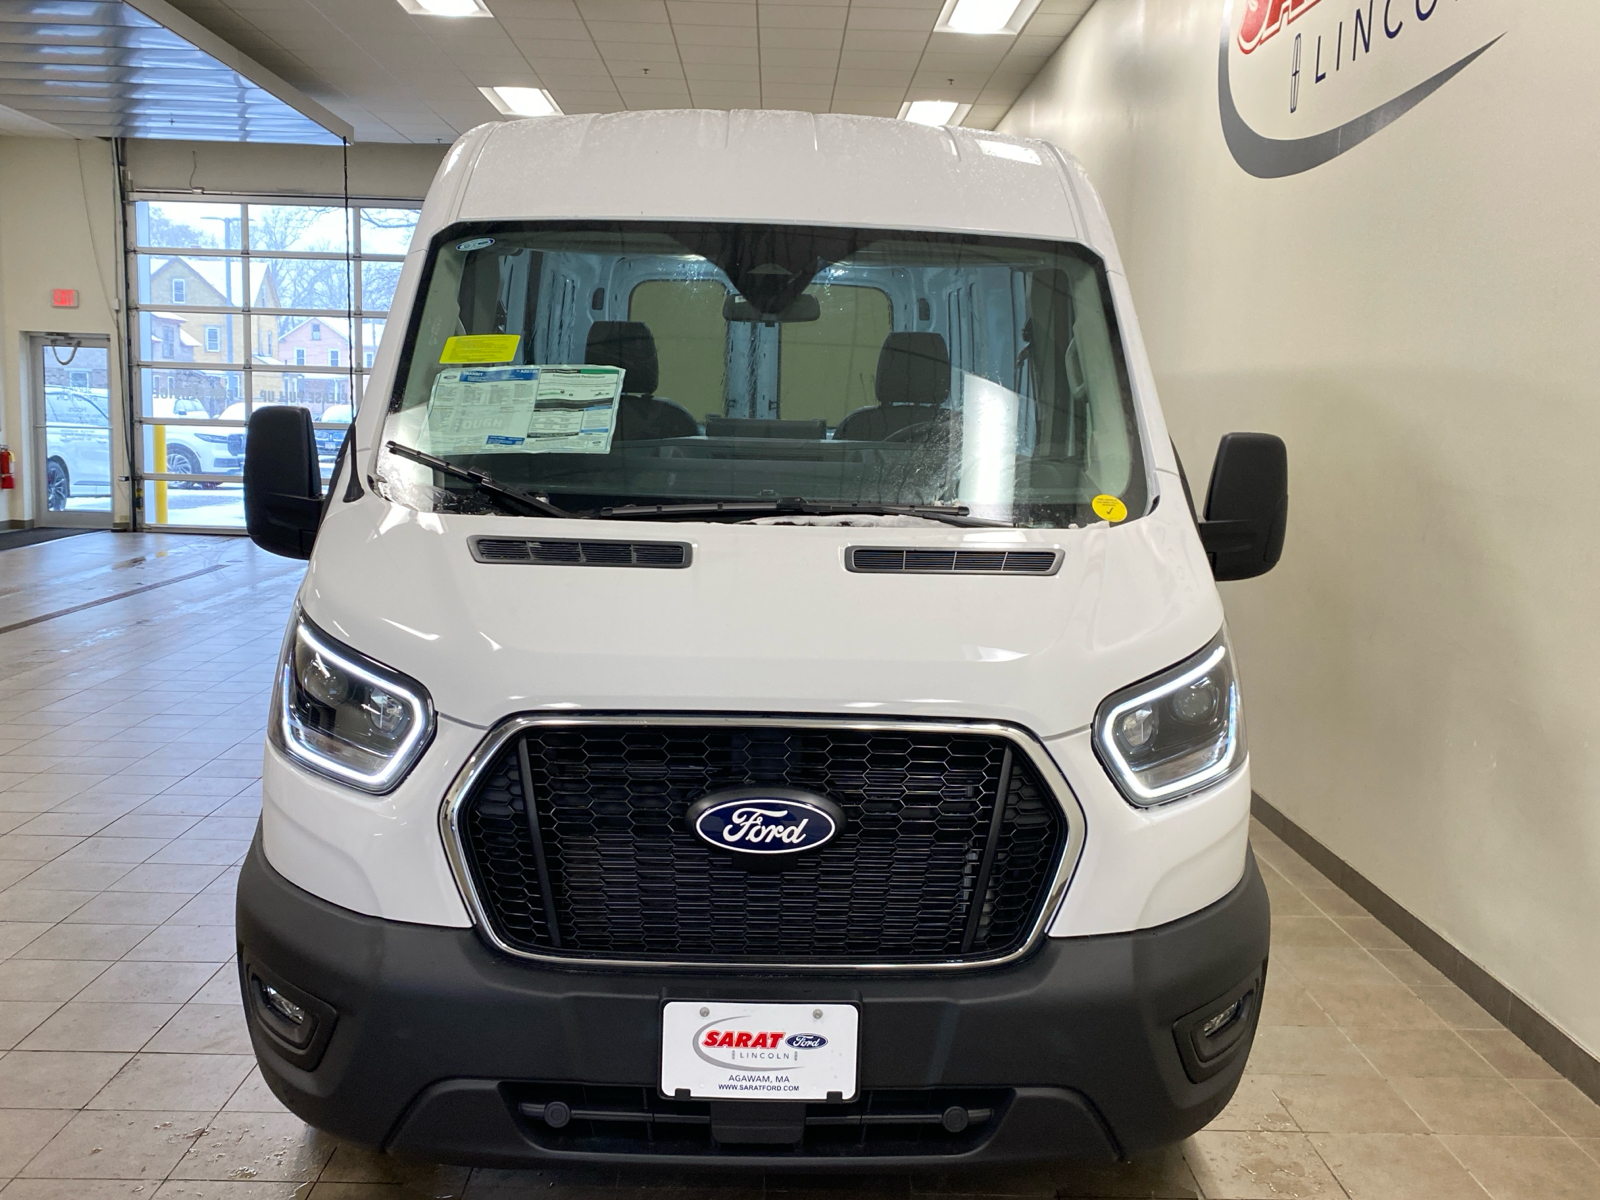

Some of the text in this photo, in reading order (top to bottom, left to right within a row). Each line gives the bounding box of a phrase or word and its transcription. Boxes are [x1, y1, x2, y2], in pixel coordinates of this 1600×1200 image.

[722, 807, 809, 844] Ford
[702, 1030, 786, 1050] SARAT
[739, 1051, 790, 1060] LINCOLN
[728, 1074, 790, 1084] AGAWAM, MA
[718, 1083, 800, 1092] WWW.SARATFORD.COM
